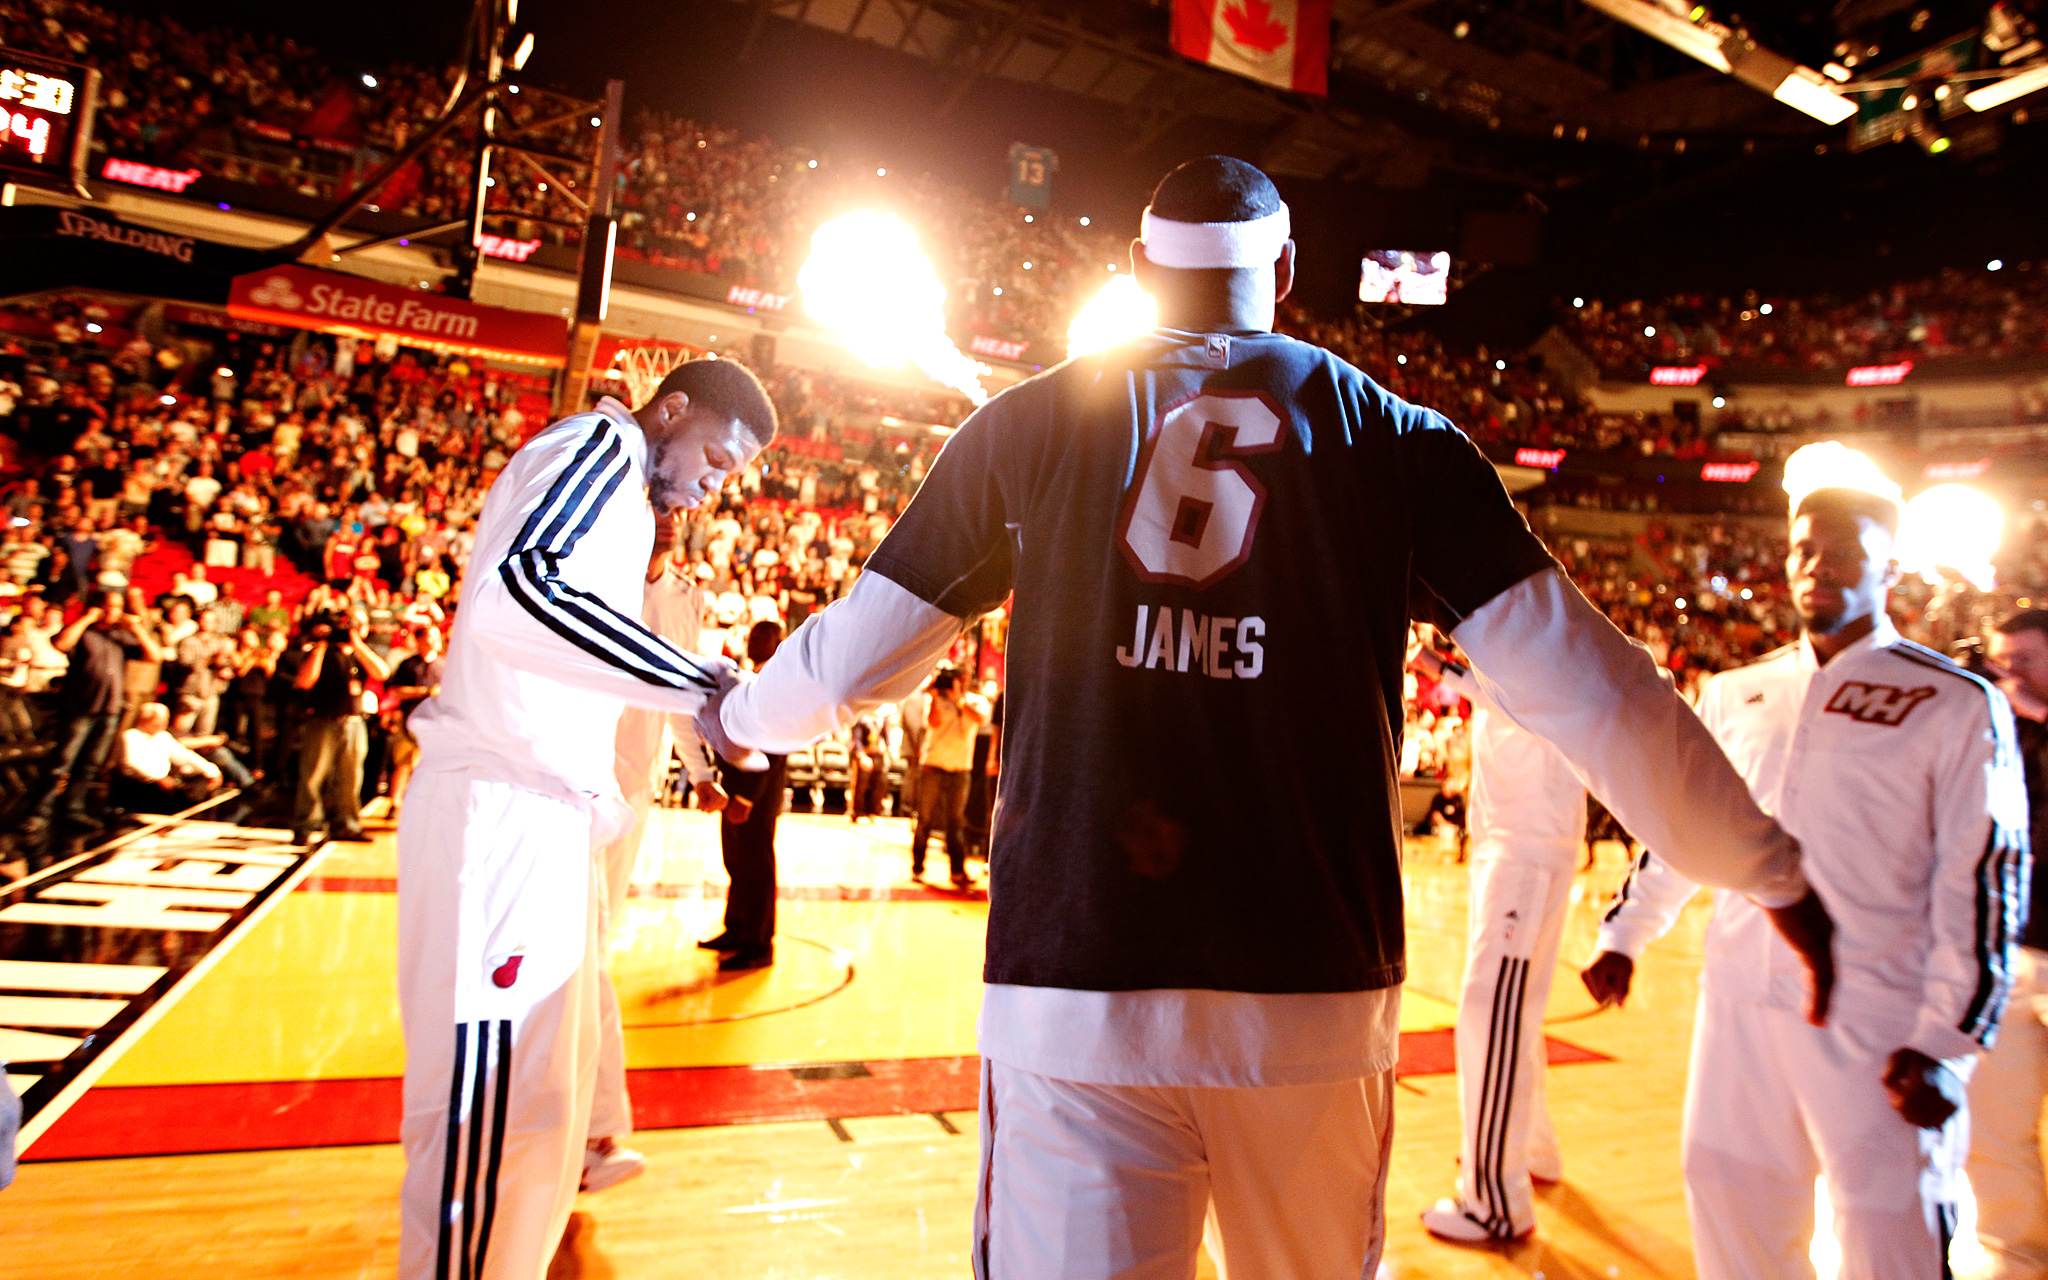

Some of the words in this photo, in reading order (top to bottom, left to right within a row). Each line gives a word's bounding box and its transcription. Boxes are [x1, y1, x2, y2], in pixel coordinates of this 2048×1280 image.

[102, 157, 202, 193] HEAT
[1020, 160, 1044, 185] 13
[56, 210, 196, 264] SPALDING
[480, 232, 542, 262] EAT
[727, 284, 794, 311] HEAT
[970, 335, 1031, 361] HEAT
[1116, 389, 1291, 590] 6
[1116, 604, 1266, 679] JAMES
